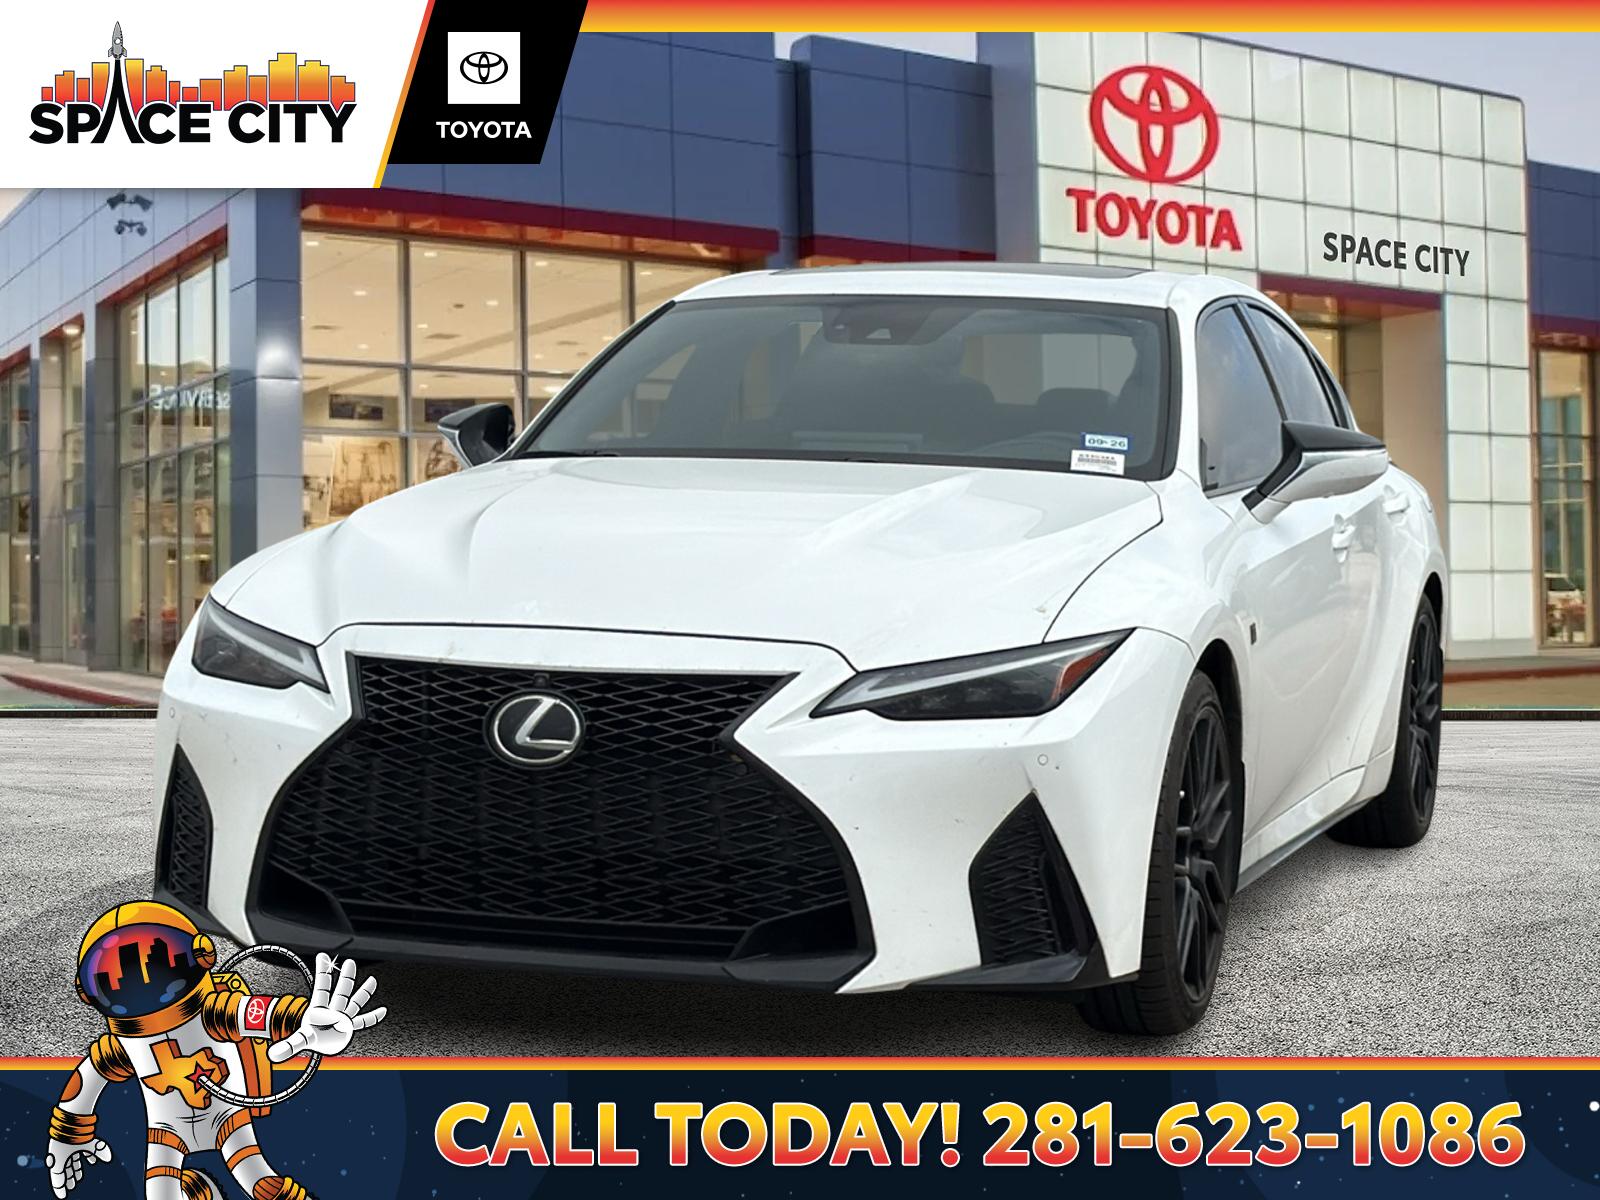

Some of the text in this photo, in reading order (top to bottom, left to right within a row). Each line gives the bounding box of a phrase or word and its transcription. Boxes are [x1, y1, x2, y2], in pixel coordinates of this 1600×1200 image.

[1066, 187, 1242, 251] TOYOTA
[1323, 232, 1470, 276] SPACE CITY
